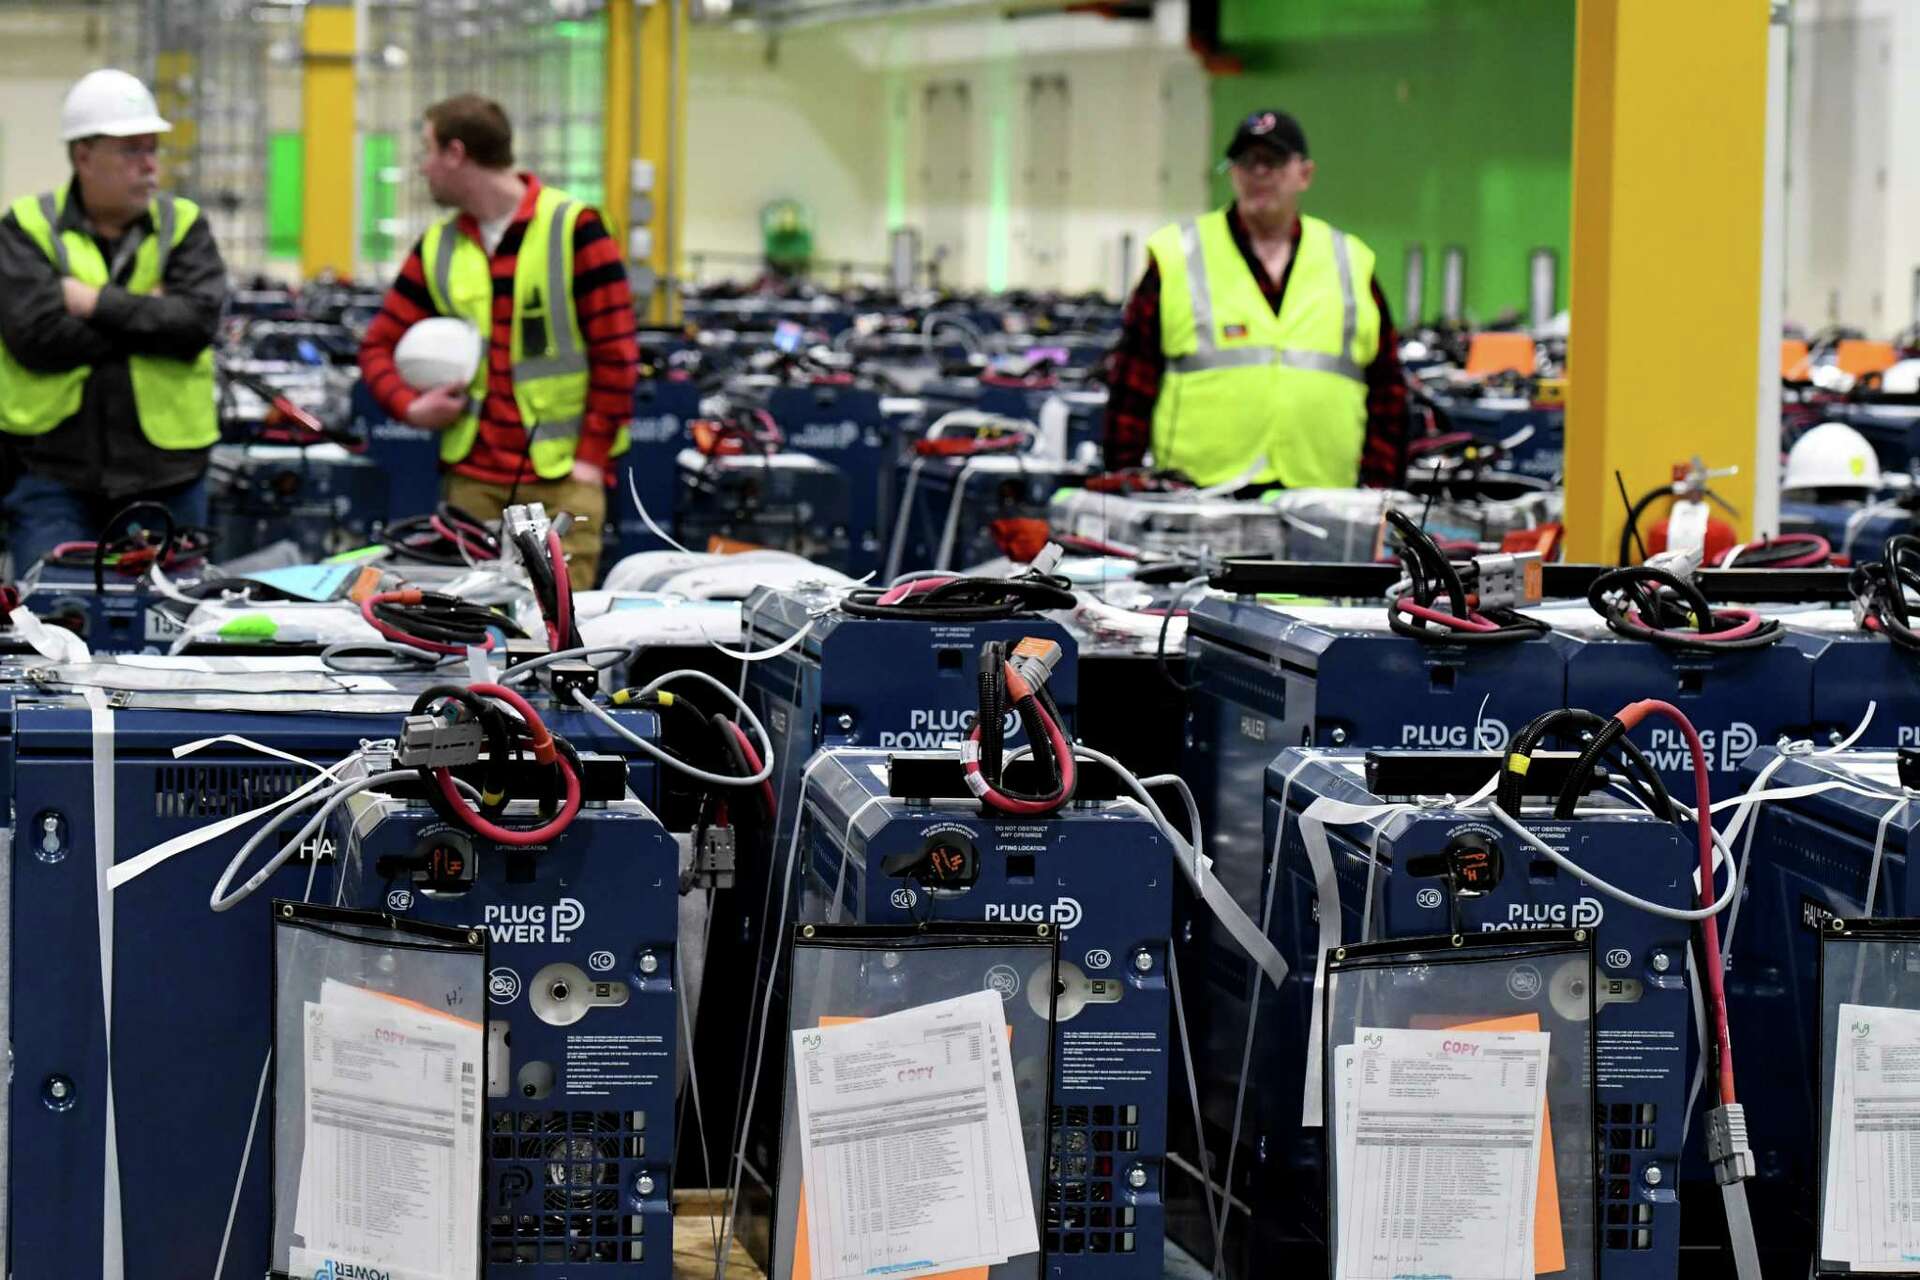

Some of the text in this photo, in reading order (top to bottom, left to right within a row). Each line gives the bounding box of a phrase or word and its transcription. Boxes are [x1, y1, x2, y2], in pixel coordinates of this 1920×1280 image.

[879, 731, 964, 748] POWE
[1402, 725, 1468, 746] PLUG
[485, 905, 545, 923] PLUG
[984, 904, 1044, 922] PLUG
[1508, 903, 1566, 922] PLUG
[1363, 1032, 1384, 1049] plug
[1442, 1039, 1480, 1056] COPY
